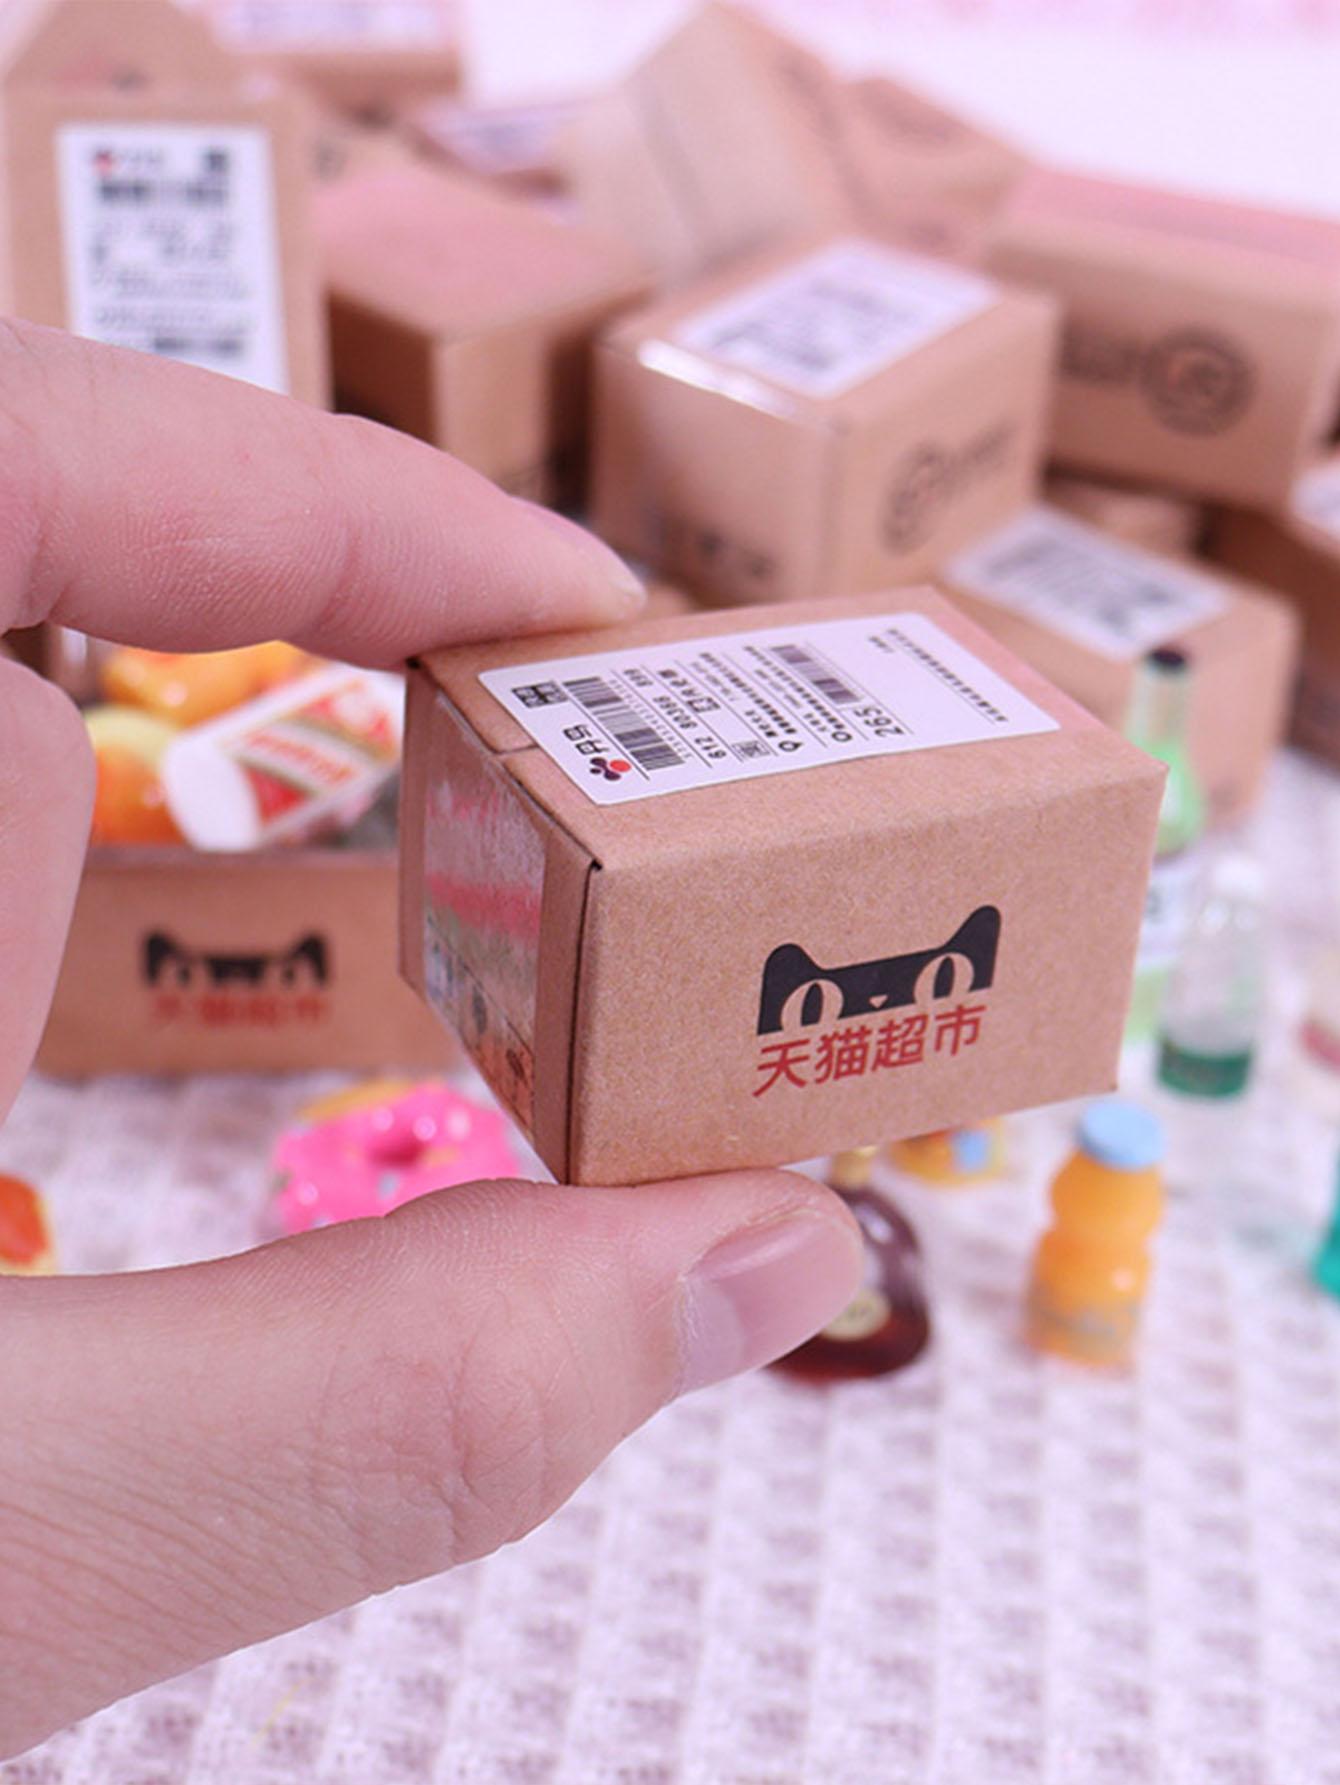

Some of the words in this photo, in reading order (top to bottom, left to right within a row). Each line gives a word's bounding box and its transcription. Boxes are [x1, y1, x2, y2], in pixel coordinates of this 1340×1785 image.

[853, 706, 905, 737] 265
[752, 1004, 986, 1098] 天猫超市
